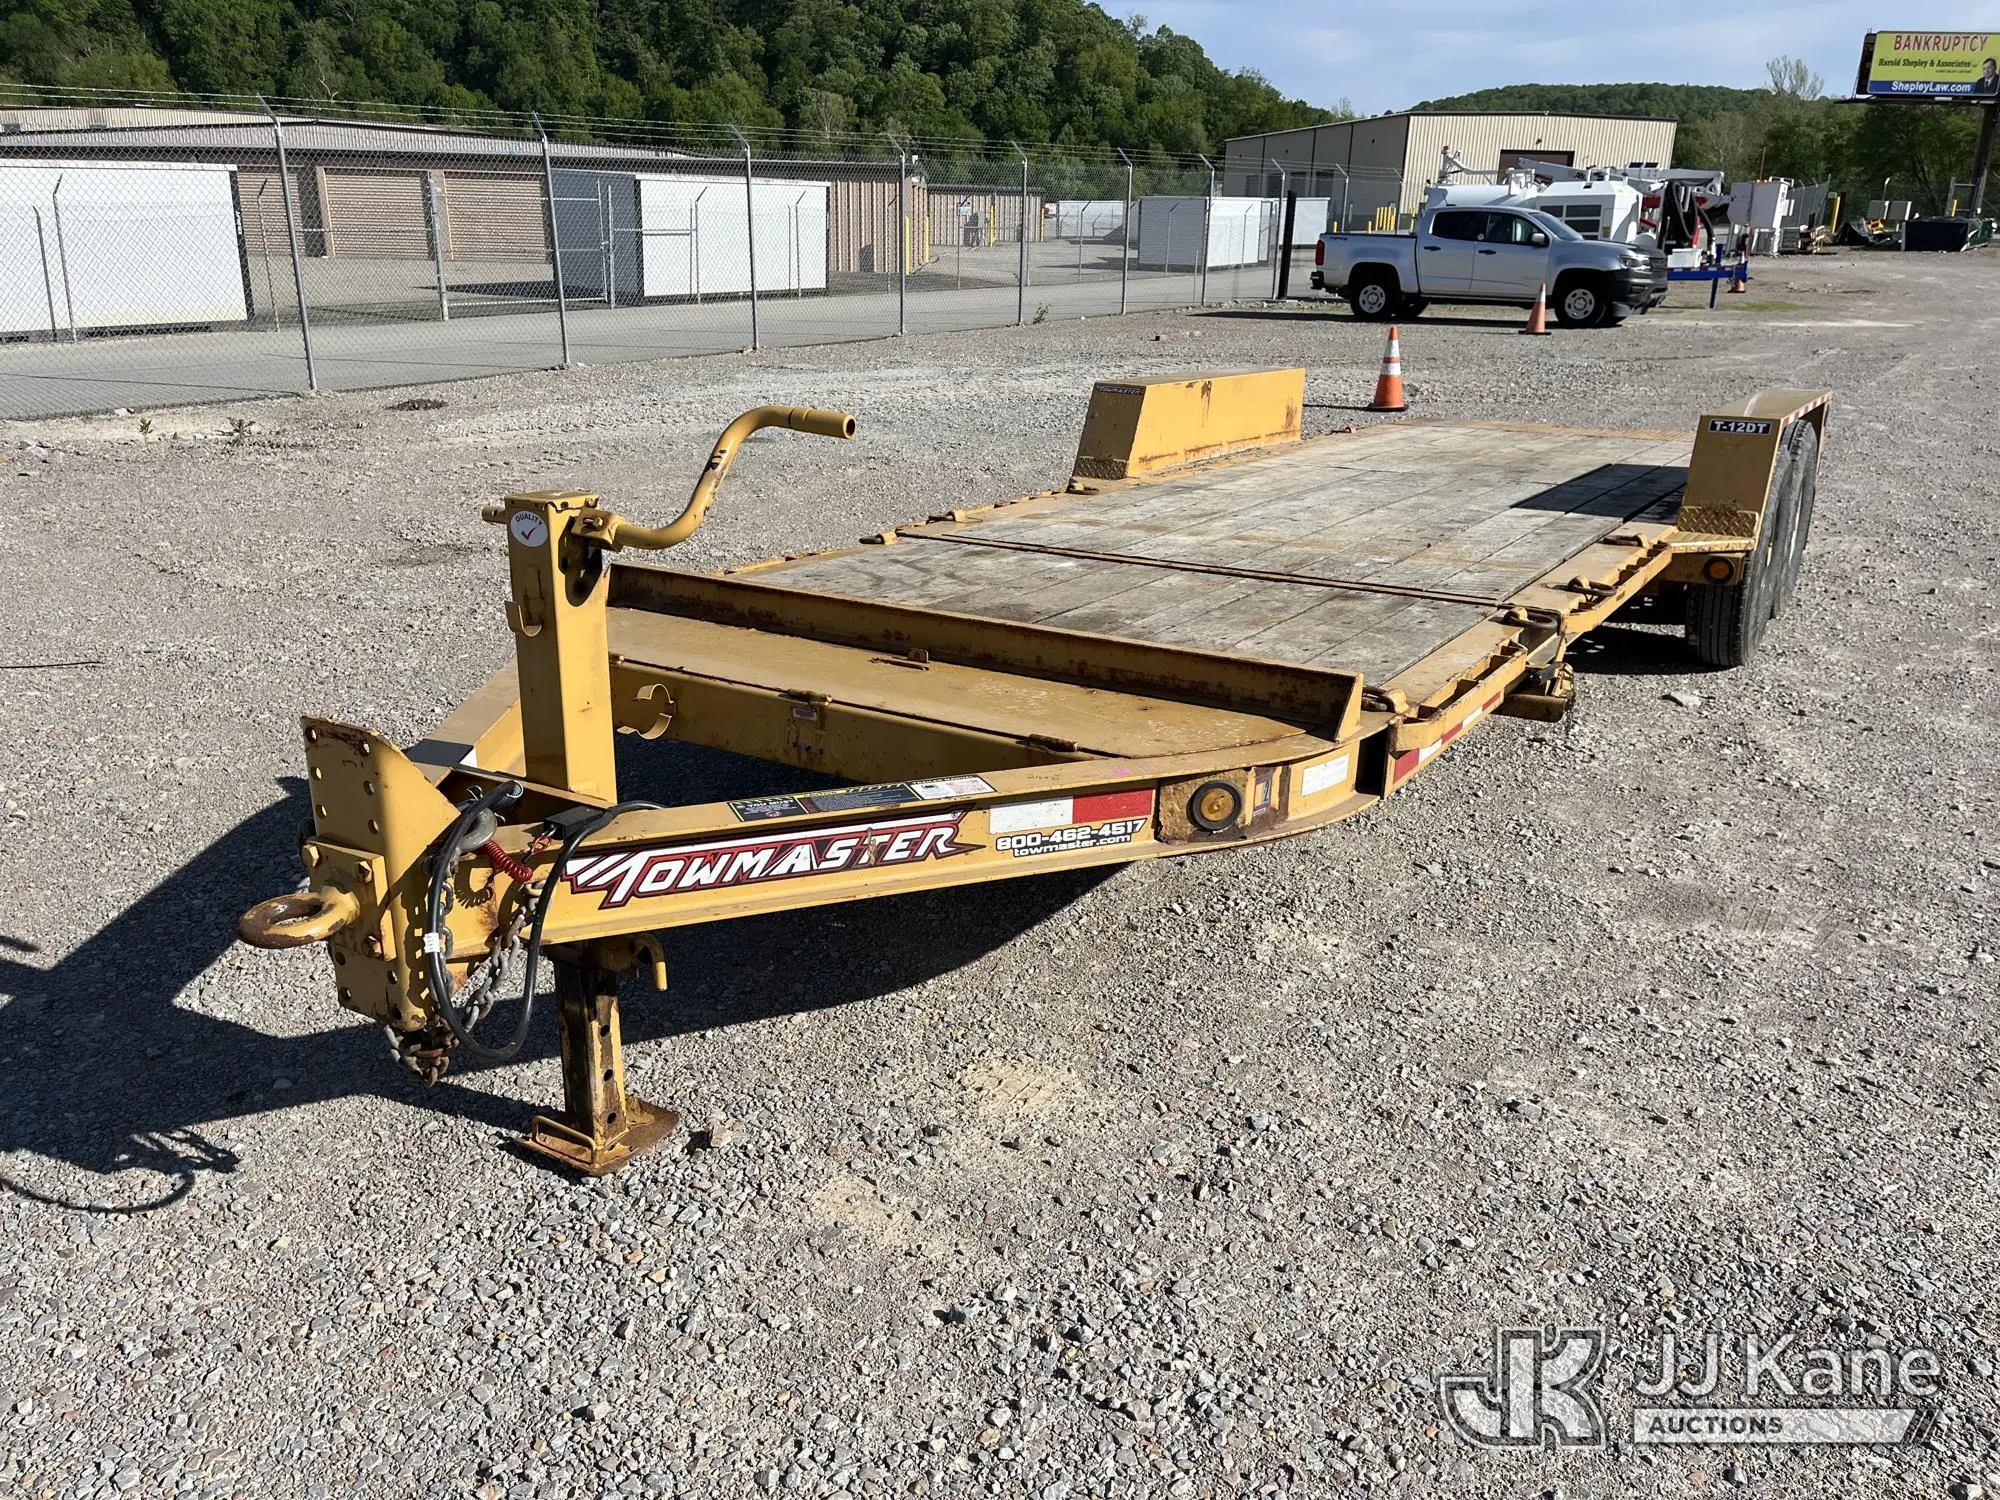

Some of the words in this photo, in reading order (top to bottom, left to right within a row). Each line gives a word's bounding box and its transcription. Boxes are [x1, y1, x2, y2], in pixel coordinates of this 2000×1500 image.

[1894, 34, 1988, 52] BANKRUPTCY
[1878, 58, 1901, 67] Harold
[1902, 58, 1928, 69] Shepley
[1930, 59, 1935, 67] &
[1936, 59, 1971, 68] Associates
[1891, 81, 1971, 93] ShepleyLaw.com
[1714, 421, 1767, 433] T-12DT
[515, 512, 543, 526] QUALITY
[997, 818, 1147, 850] 800-462-4517
[1014, 835, 1130, 857] towmaster.com
[566, 812, 974, 906] TOWMASTER
